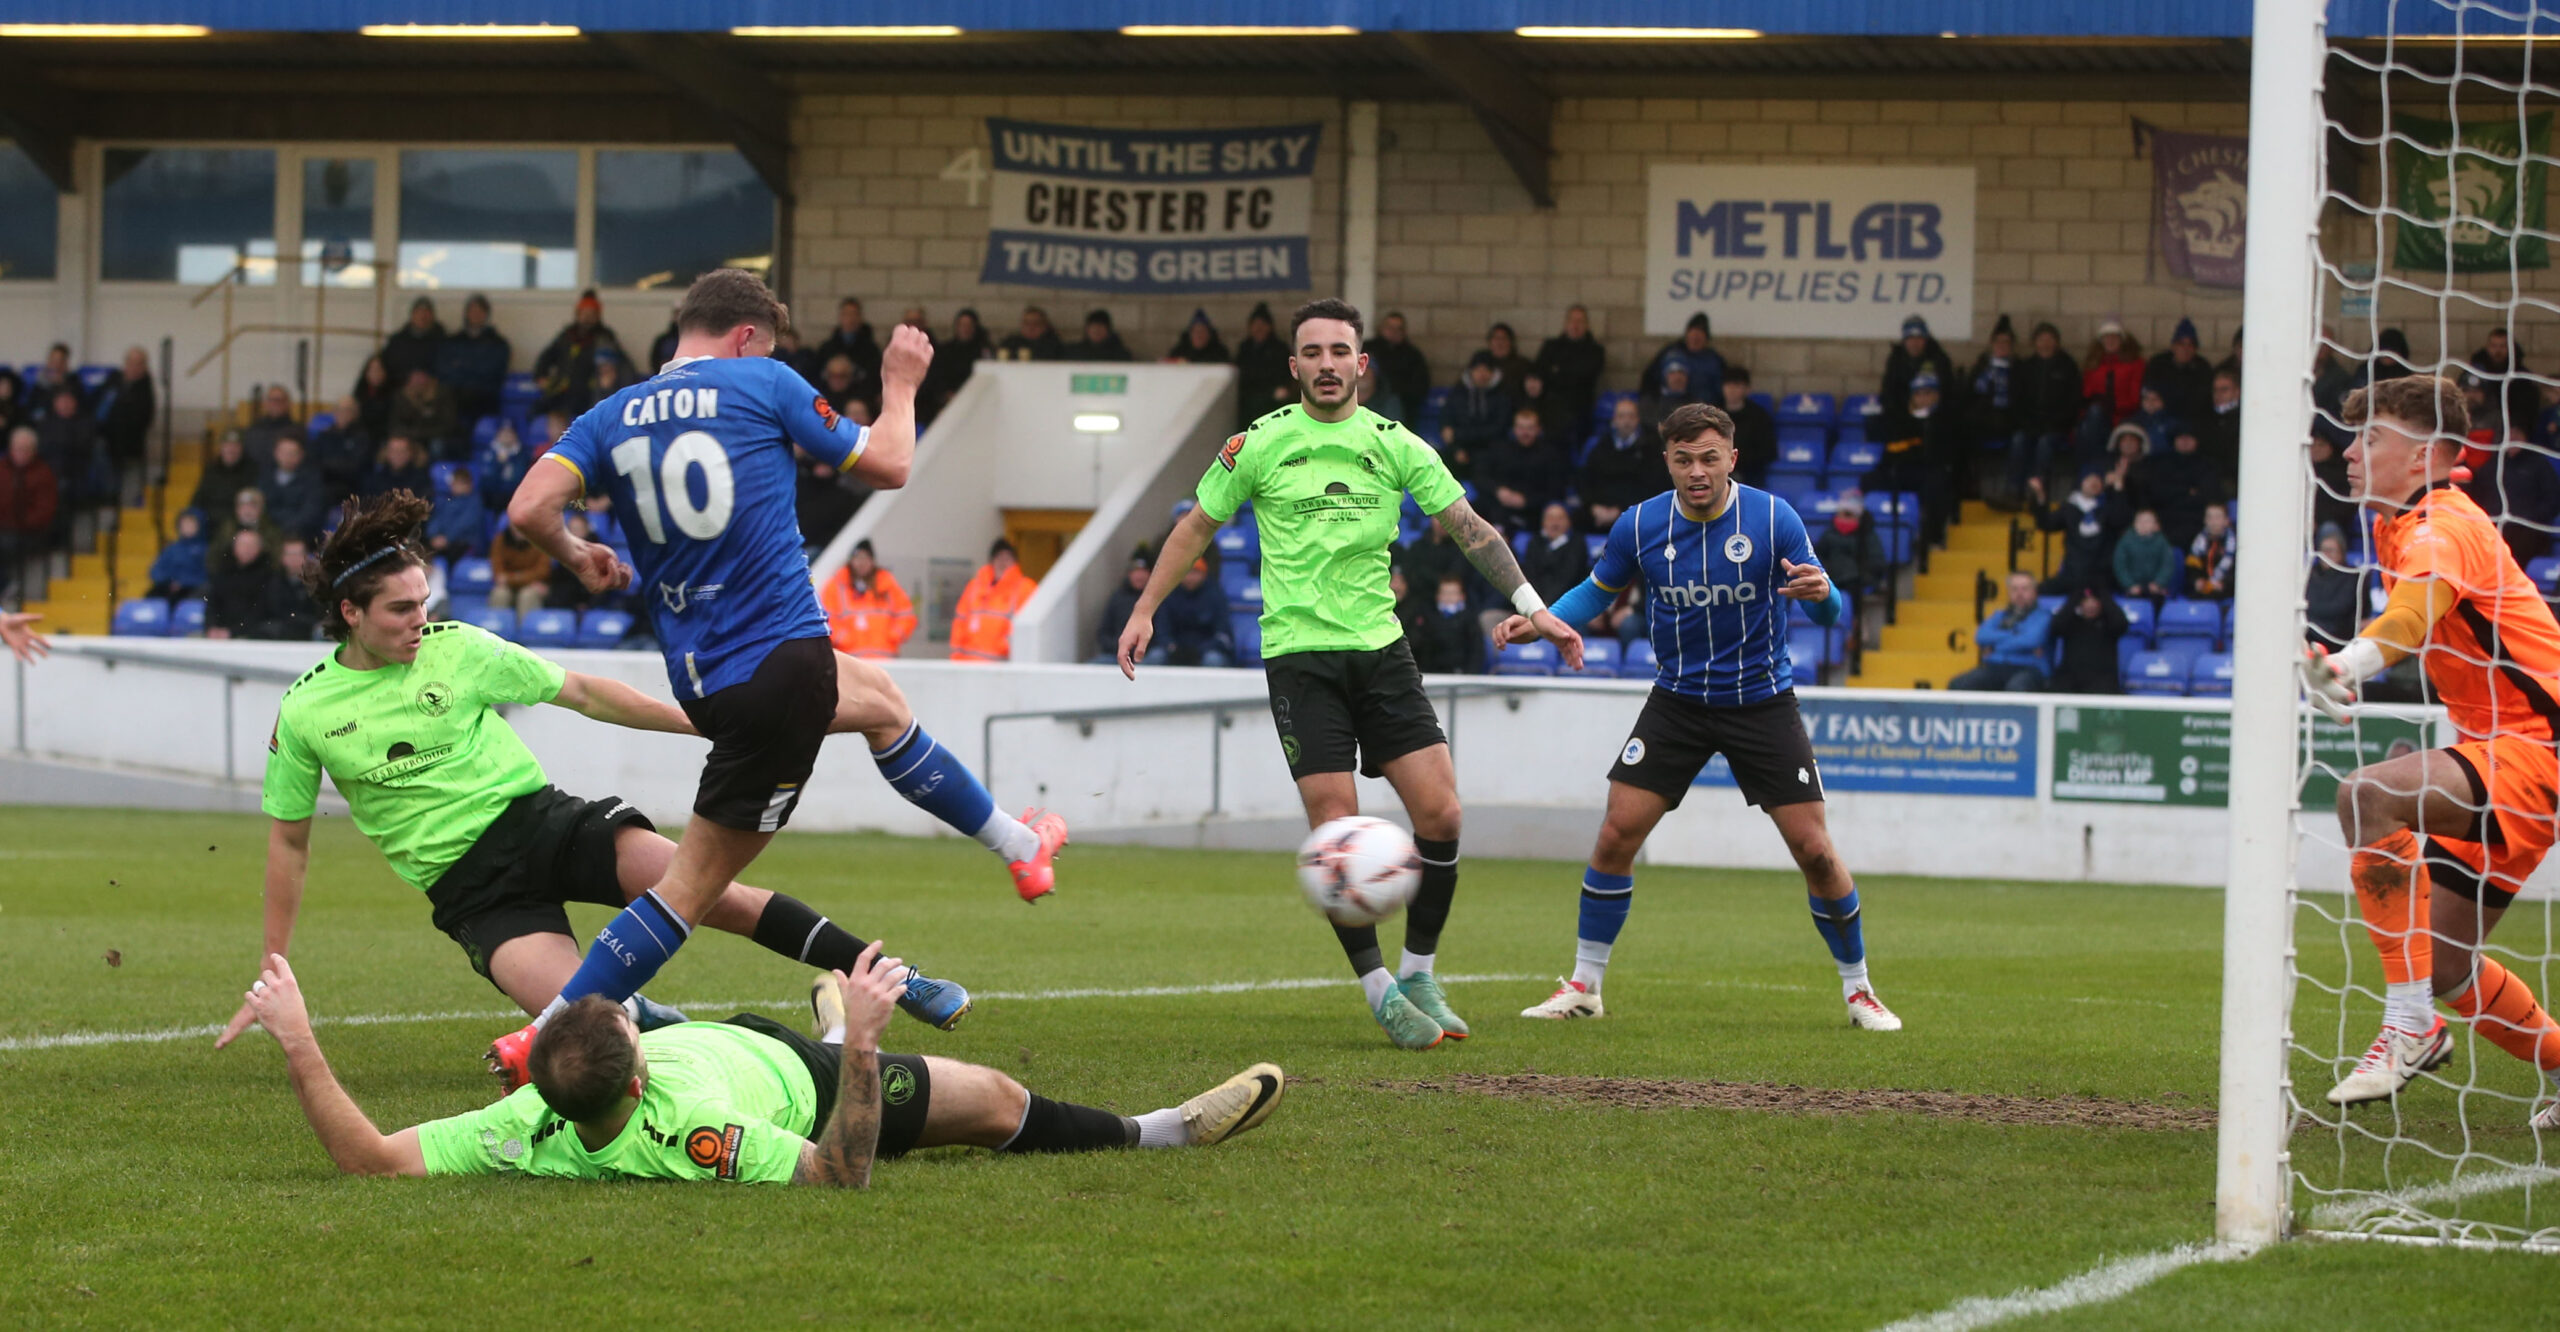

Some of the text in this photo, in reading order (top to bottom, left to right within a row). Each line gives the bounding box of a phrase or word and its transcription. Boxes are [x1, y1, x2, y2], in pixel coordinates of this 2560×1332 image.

[1002, 131, 1311, 174] UNTIL THE SKY
[940, 148, 987, 206] 4
[1026, 182, 1274, 232] CHESTER FC
[1676, 199, 1943, 261] METLAB
[1002, 241, 1290, 282] TURNS GREEN
[1668, 268, 1951, 304] SUPPLIES LTD.
[623, 388, 718, 426] CATON
[611, 430, 734, 544] 10
[1659, 580, 1757, 608] mbna
[1827, 713, 1901, 741] FANS
[1909, 717, 2022, 746] UNITED
